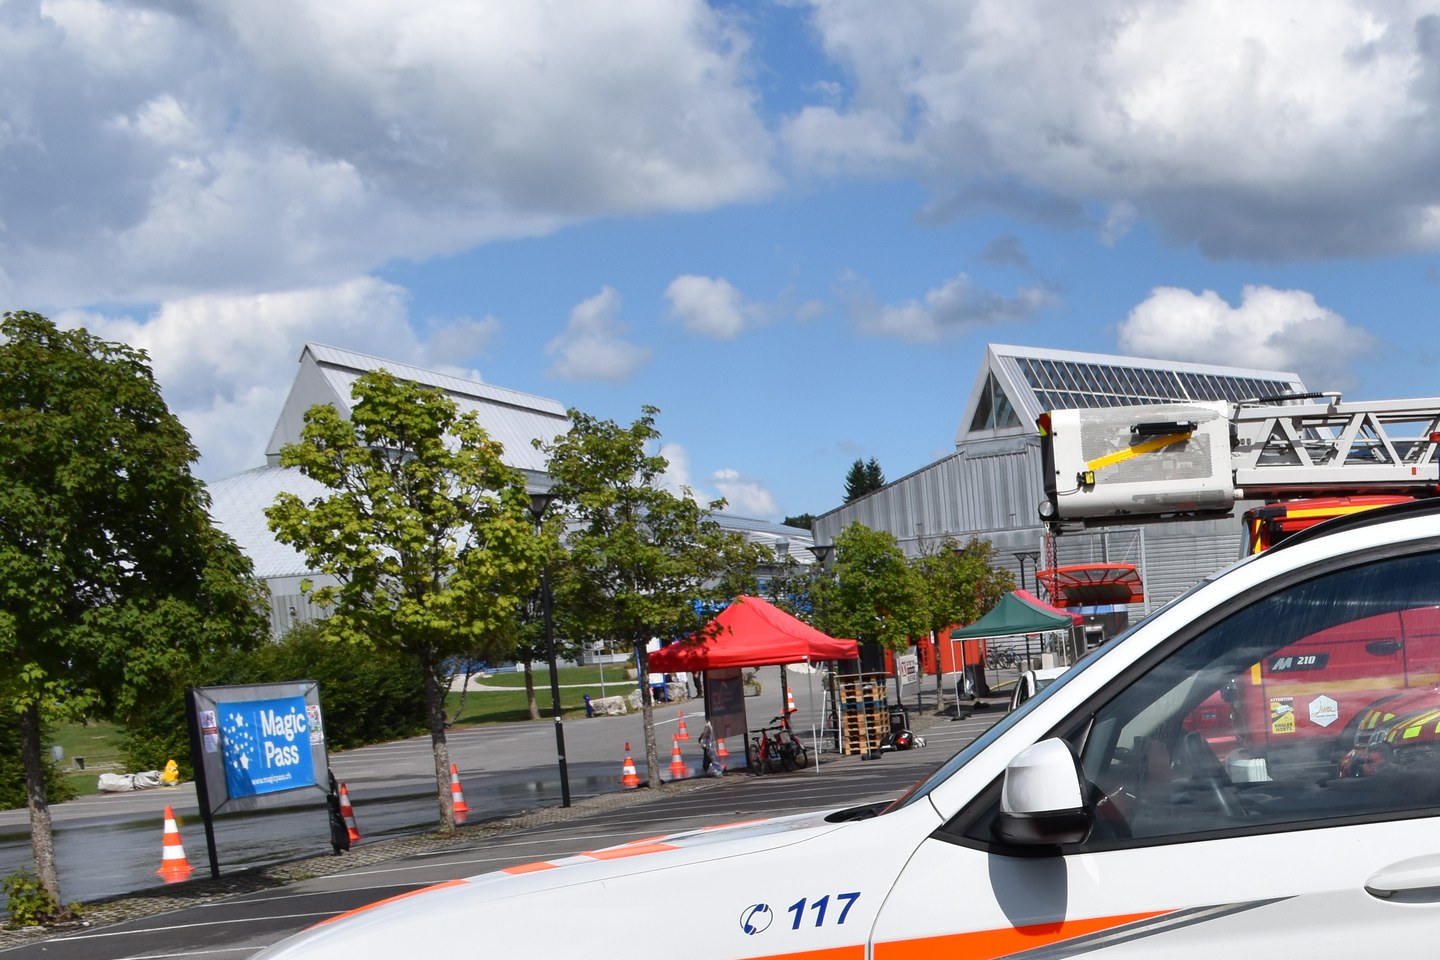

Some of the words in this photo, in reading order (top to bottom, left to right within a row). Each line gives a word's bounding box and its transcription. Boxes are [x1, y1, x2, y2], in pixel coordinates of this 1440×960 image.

[1297, 655, 1316, 665] 210
[260, 706, 306, 741] Magic
[264, 741, 300, 768] Pass
[787, 891, 862, 930] 117
